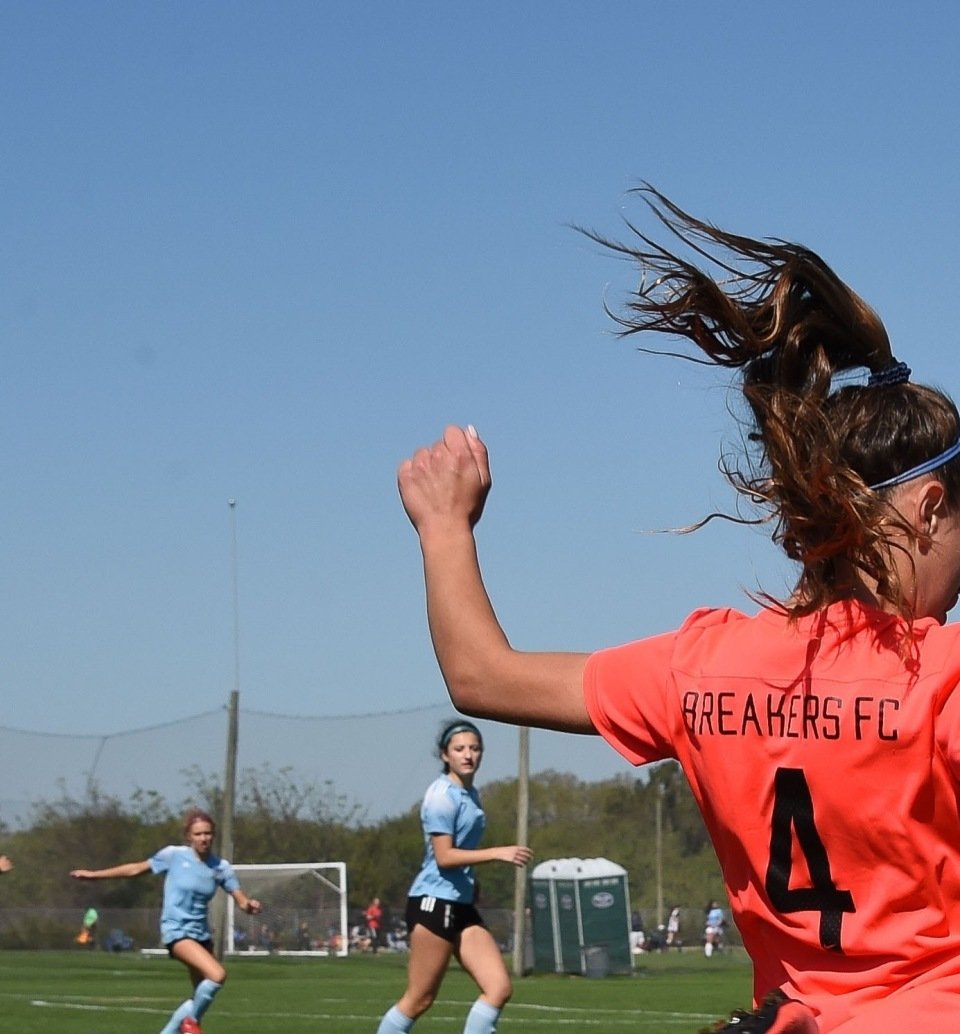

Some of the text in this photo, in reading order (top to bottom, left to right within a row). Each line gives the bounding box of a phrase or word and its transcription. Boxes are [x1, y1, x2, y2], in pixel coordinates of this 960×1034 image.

[683, 691, 900, 741] BREAKERS FC
[765, 766, 857, 952] 4
